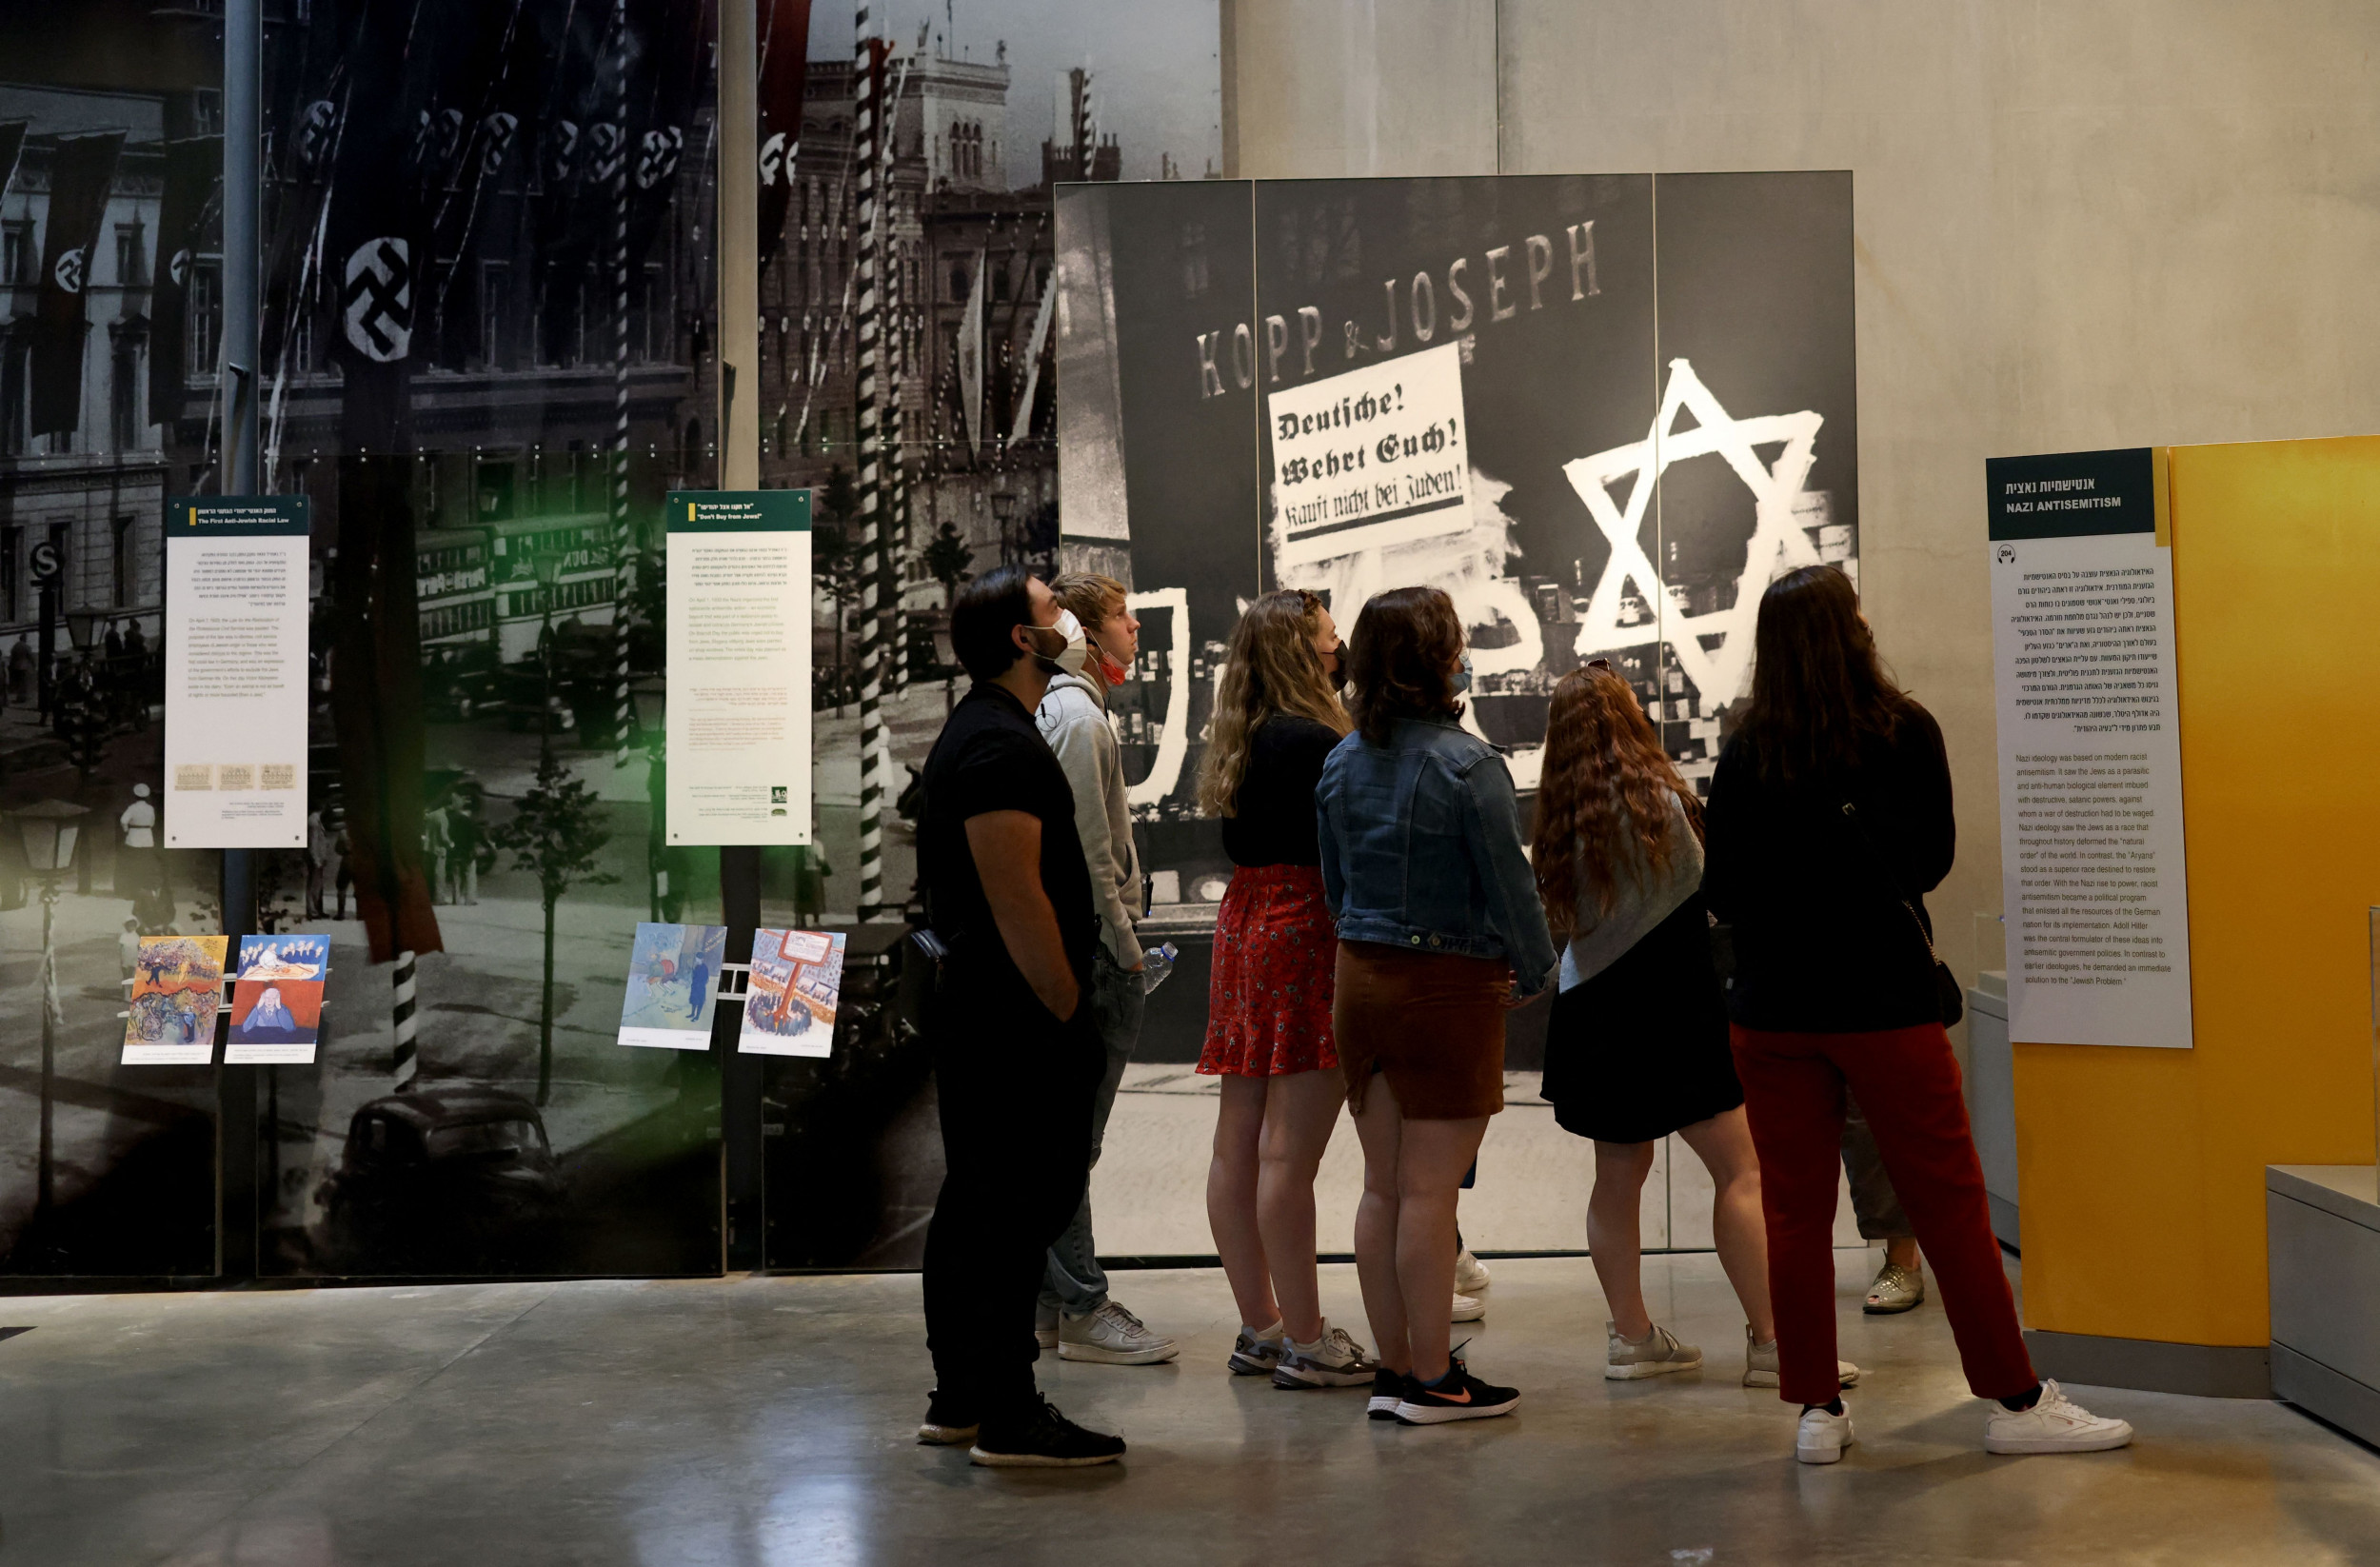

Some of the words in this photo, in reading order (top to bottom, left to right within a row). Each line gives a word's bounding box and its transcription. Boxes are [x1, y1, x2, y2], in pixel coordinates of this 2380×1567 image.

[1197, 306, 1322, 399] KOPP
[1344, 320, 1370, 359] &
[1377, 220, 1601, 352] JOSEPH
[1281, 445, 1365, 486] Wehrt
[1377, 418, 1458, 464] Euch!
[2005, 482, 2037, 495] נאצית
[2039, 478, 2094, 493] אנטישמיות
[1285, 494, 1328, 528] Kauft
[1334, 484, 1370, 518] nicht
[1375, 478, 1399, 508] bei
[1405, 464, 1463, 506] Juden!
[2006, 502, 2033, 513] NAZI
[2037, 497, 2122, 511] ANTISEMITISM
[36, 545, 58, 576] S
[2032, 755, 2058, 764] ideology
[2122, 767, 2150, 776] parasitic
[2067, 782, 2096, 791] biological
[2119, 796, 2142, 804] against
[2034, 823, 2060, 833] ideology
[2019, 838, 2053, 846] throughout
[2053, 838, 2075, 846] history
[2080, 879, 2095, 887] Nazi
[2094, 894, 2119, 903] political
[2119, 895, 2147, 903] program
[2133, 907, 2161, 916] German
